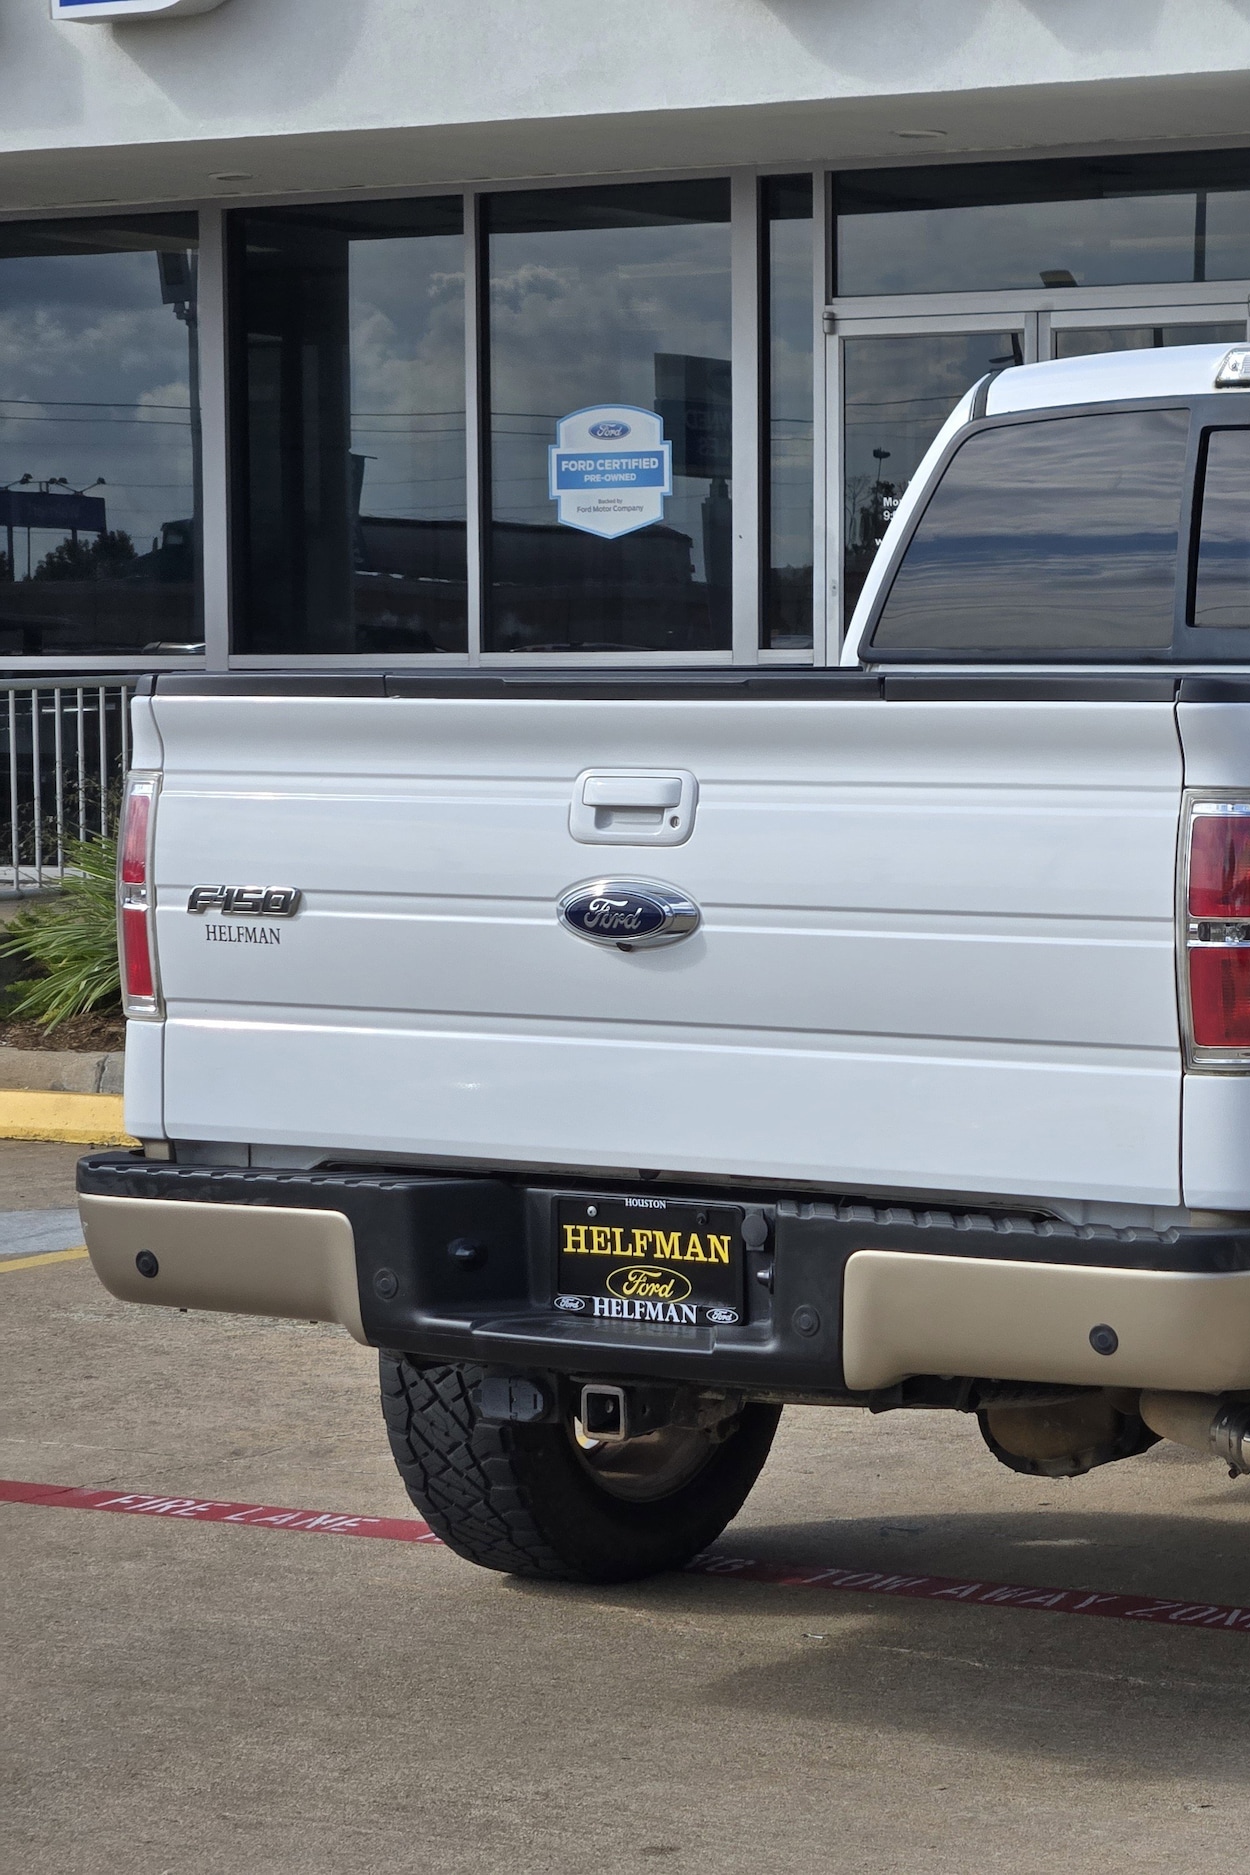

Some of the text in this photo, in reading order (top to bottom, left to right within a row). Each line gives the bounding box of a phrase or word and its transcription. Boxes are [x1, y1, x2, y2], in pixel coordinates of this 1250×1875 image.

[596, 424, 623, 437] Ford
[561, 457, 659, 472] FORD CERTIFIED
[584, 473, 637, 483] PRE-OWNED
[613, 505, 644, 513] Company
[883, 497, 902, 507] Mo
[583, 897, 643, 930] Ford
[205, 924, 281, 945] HELFMAN
[625, 1198, 667, 1209] HOUSTON
[563, 1224, 732, 1264] HELFMAN
[622, 1269, 675, 1298] Ford
[559, 1297, 580, 1309] Ford
[592, 1296, 698, 1324] HELFMAN
[711, 1309, 733, 1321] Ford
[95, 1494, 231, 1516] FIRE
[224, 1507, 381, 1532] LANE
[801, 1569, 929, 1591] TOW
[930, 1583, 1119, 1610] AWAY
